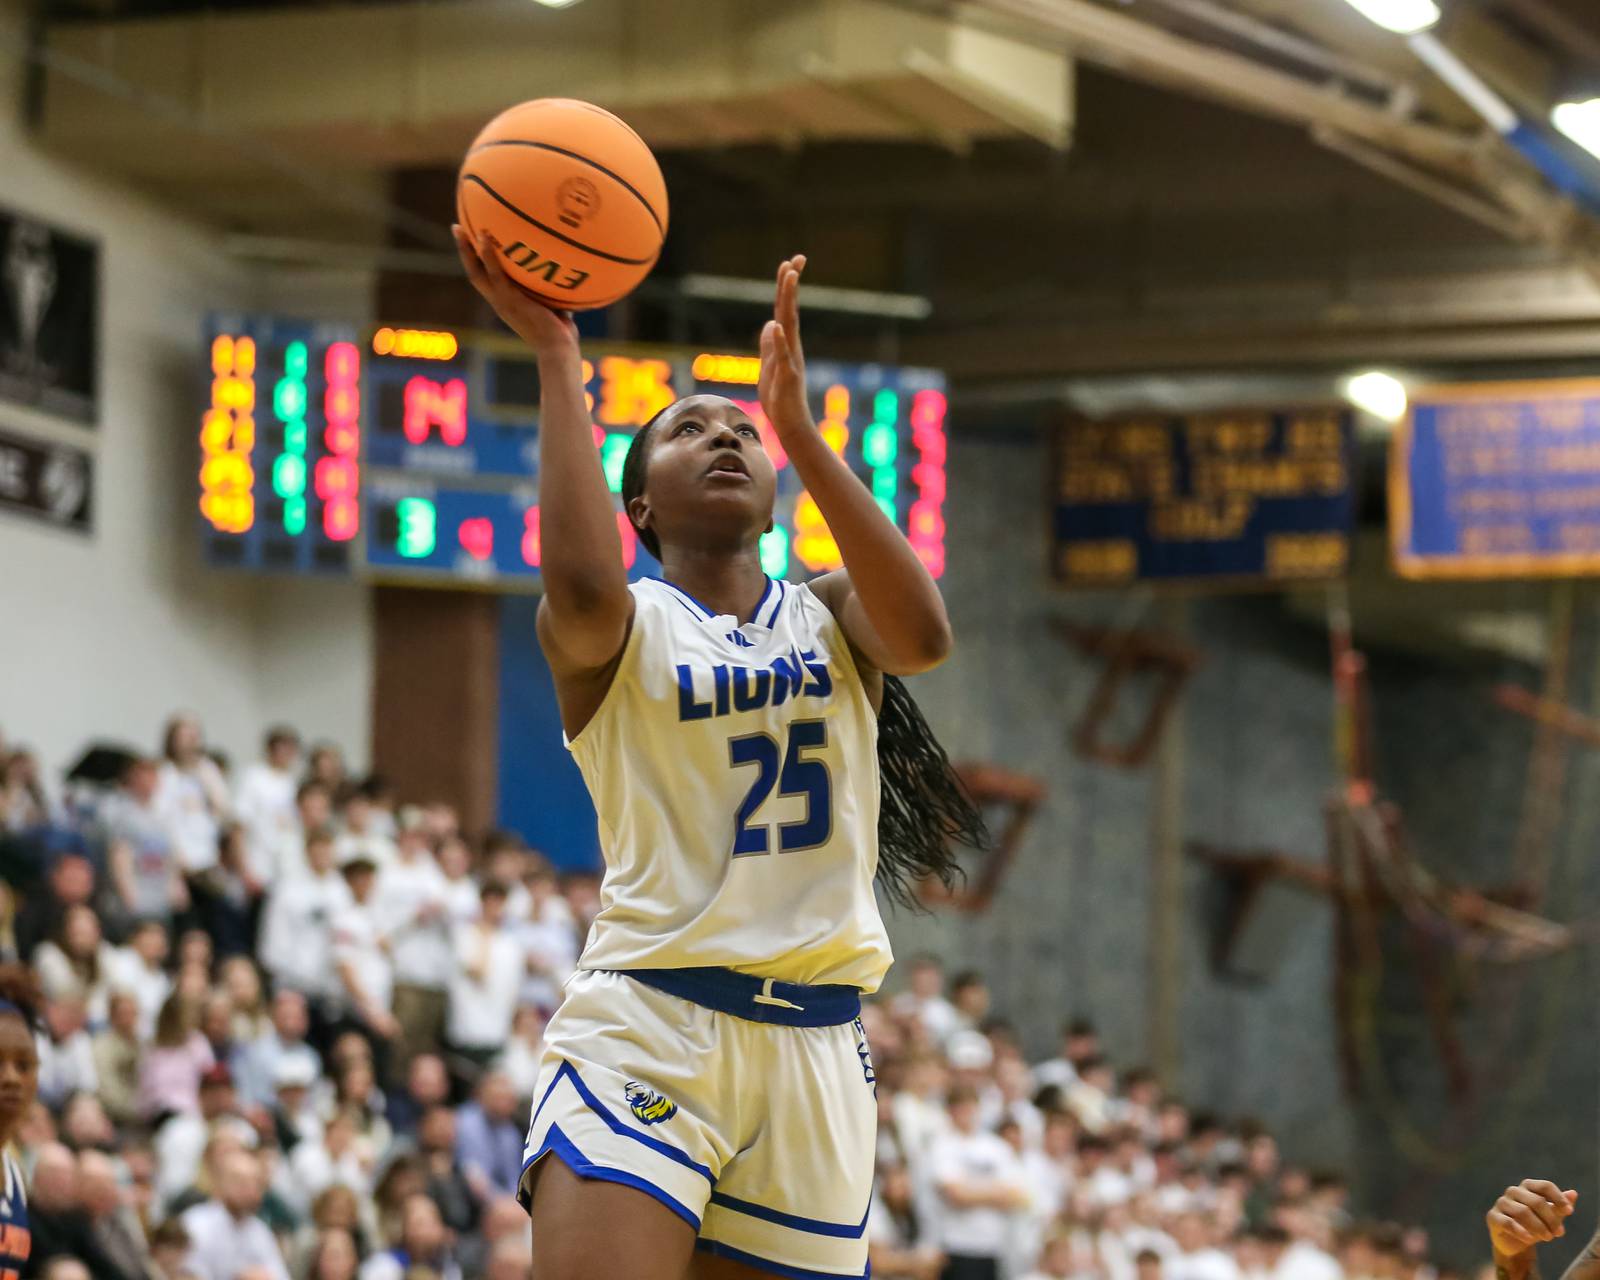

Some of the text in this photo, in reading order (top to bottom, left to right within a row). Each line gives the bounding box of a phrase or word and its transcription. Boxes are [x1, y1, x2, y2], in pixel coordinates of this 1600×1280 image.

[503, 241, 590, 290] EVO
[676, 645, 833, 722] LIONS
[727, 717, 834, 859] 25
